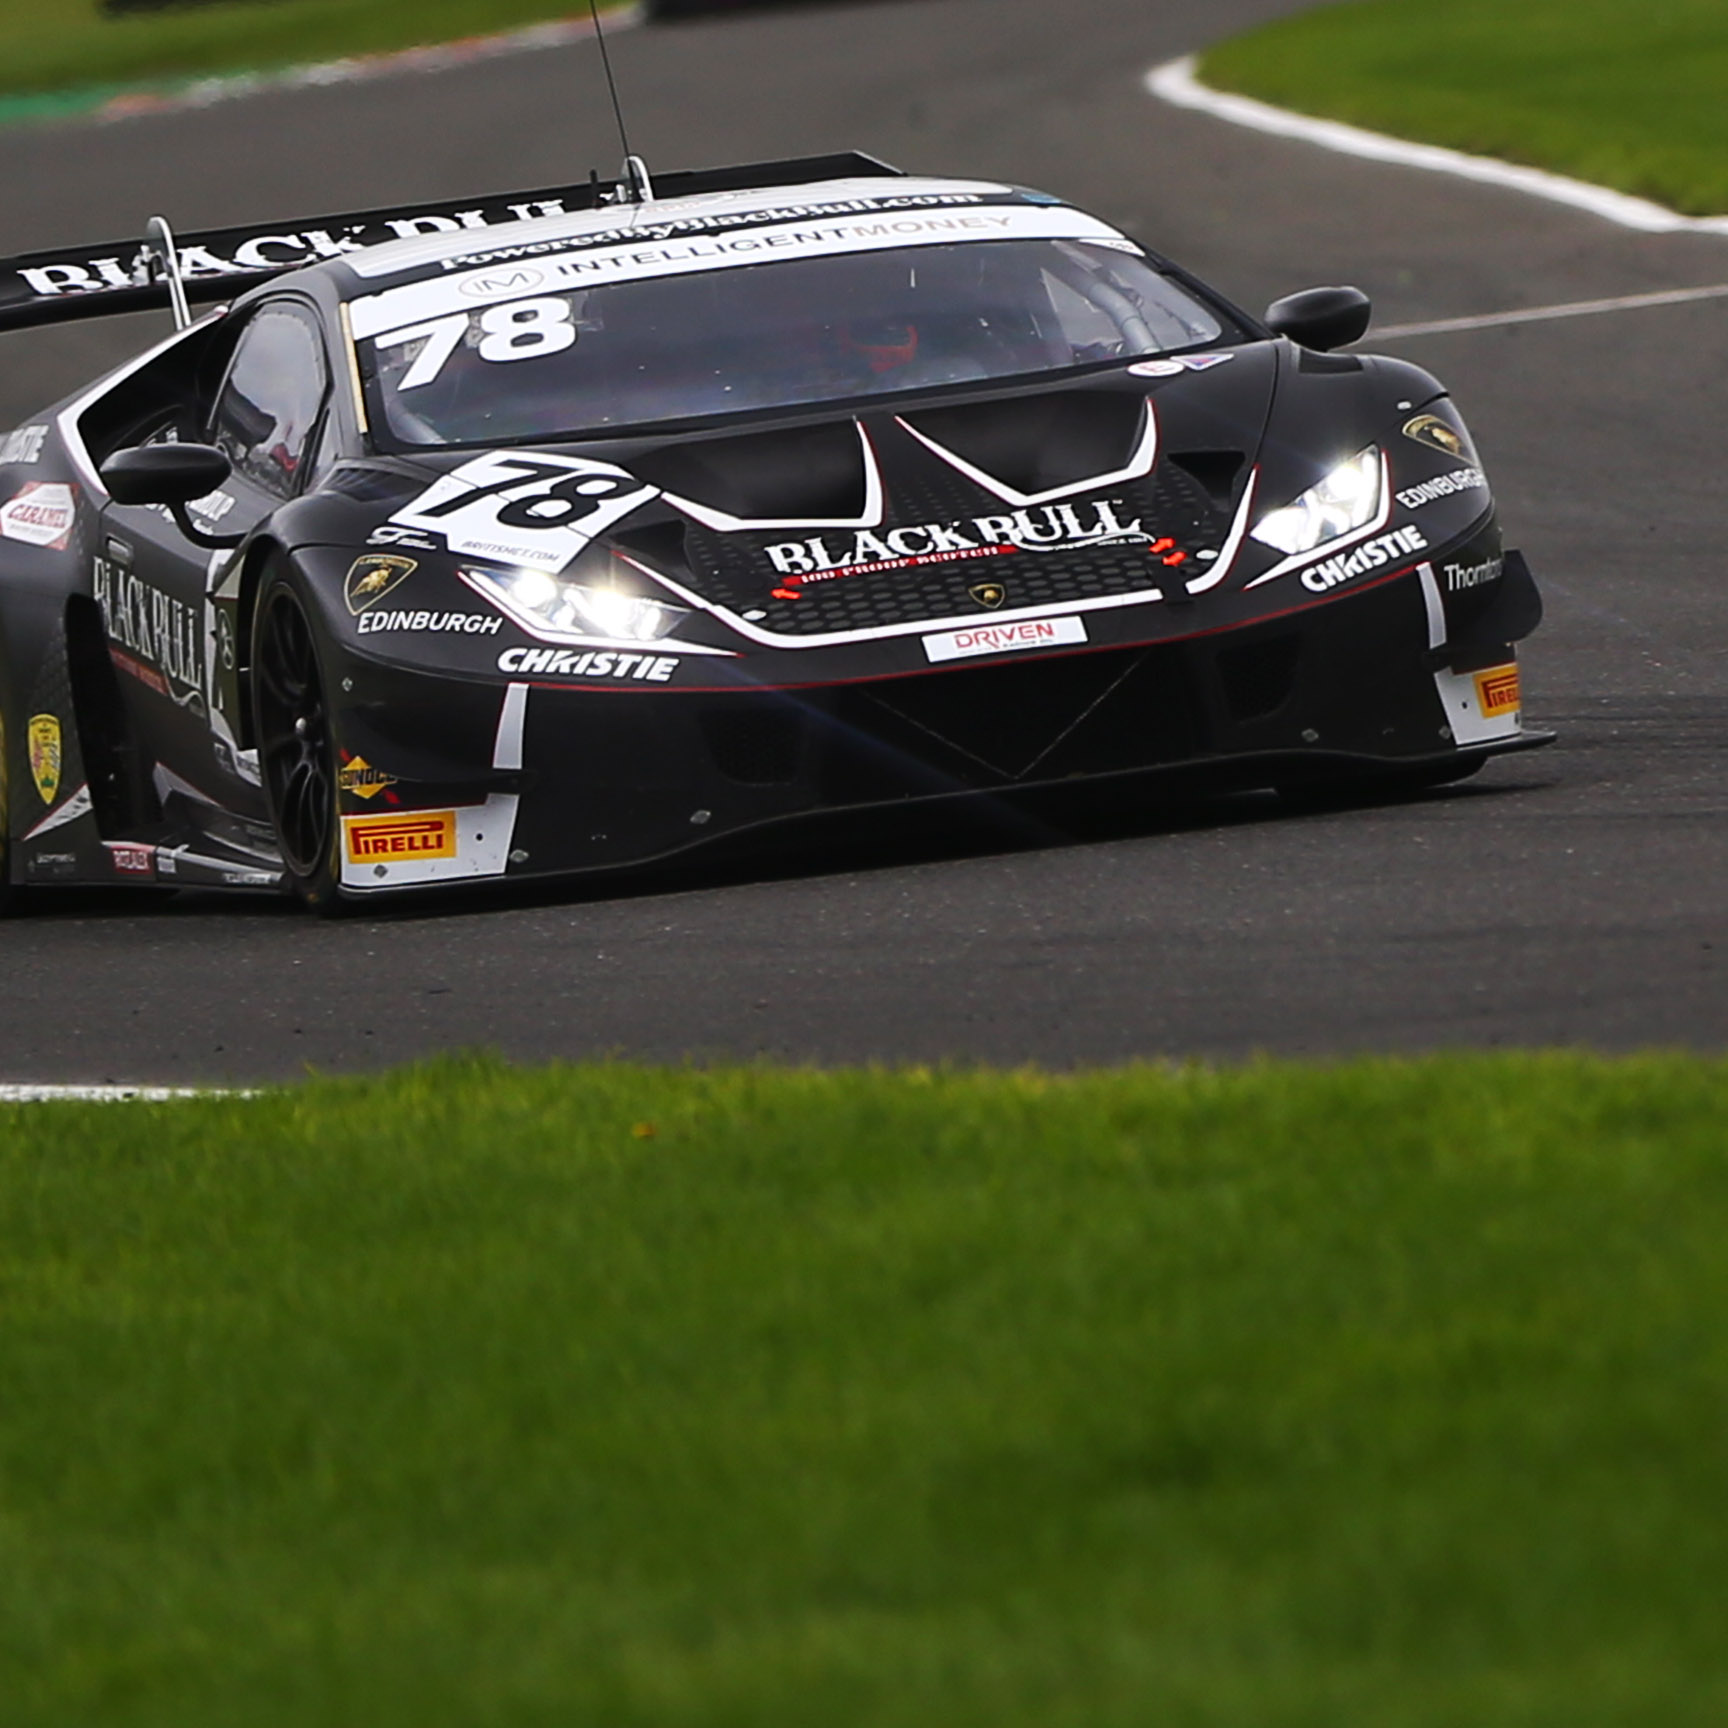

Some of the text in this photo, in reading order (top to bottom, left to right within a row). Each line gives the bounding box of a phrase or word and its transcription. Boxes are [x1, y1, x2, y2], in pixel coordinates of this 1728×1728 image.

[557, 216, 1010, 276] INTELLIGENTMONEY
[375, 297, 576, 391] 78
[415, 458, 647, 529] 78
[764, 519, 979, 574] BLACK
[972, 501, 1142, 551] BULL
[1301, 524, 1429, 593] CHRISTIE
[357, 611, 503, 635] EDINBURGH
[954, 622, 1055, 649] DRIVEN
[497, 647, 679, 683] CHRISTIE
[350, 820, 445, 855] PIRELLI
